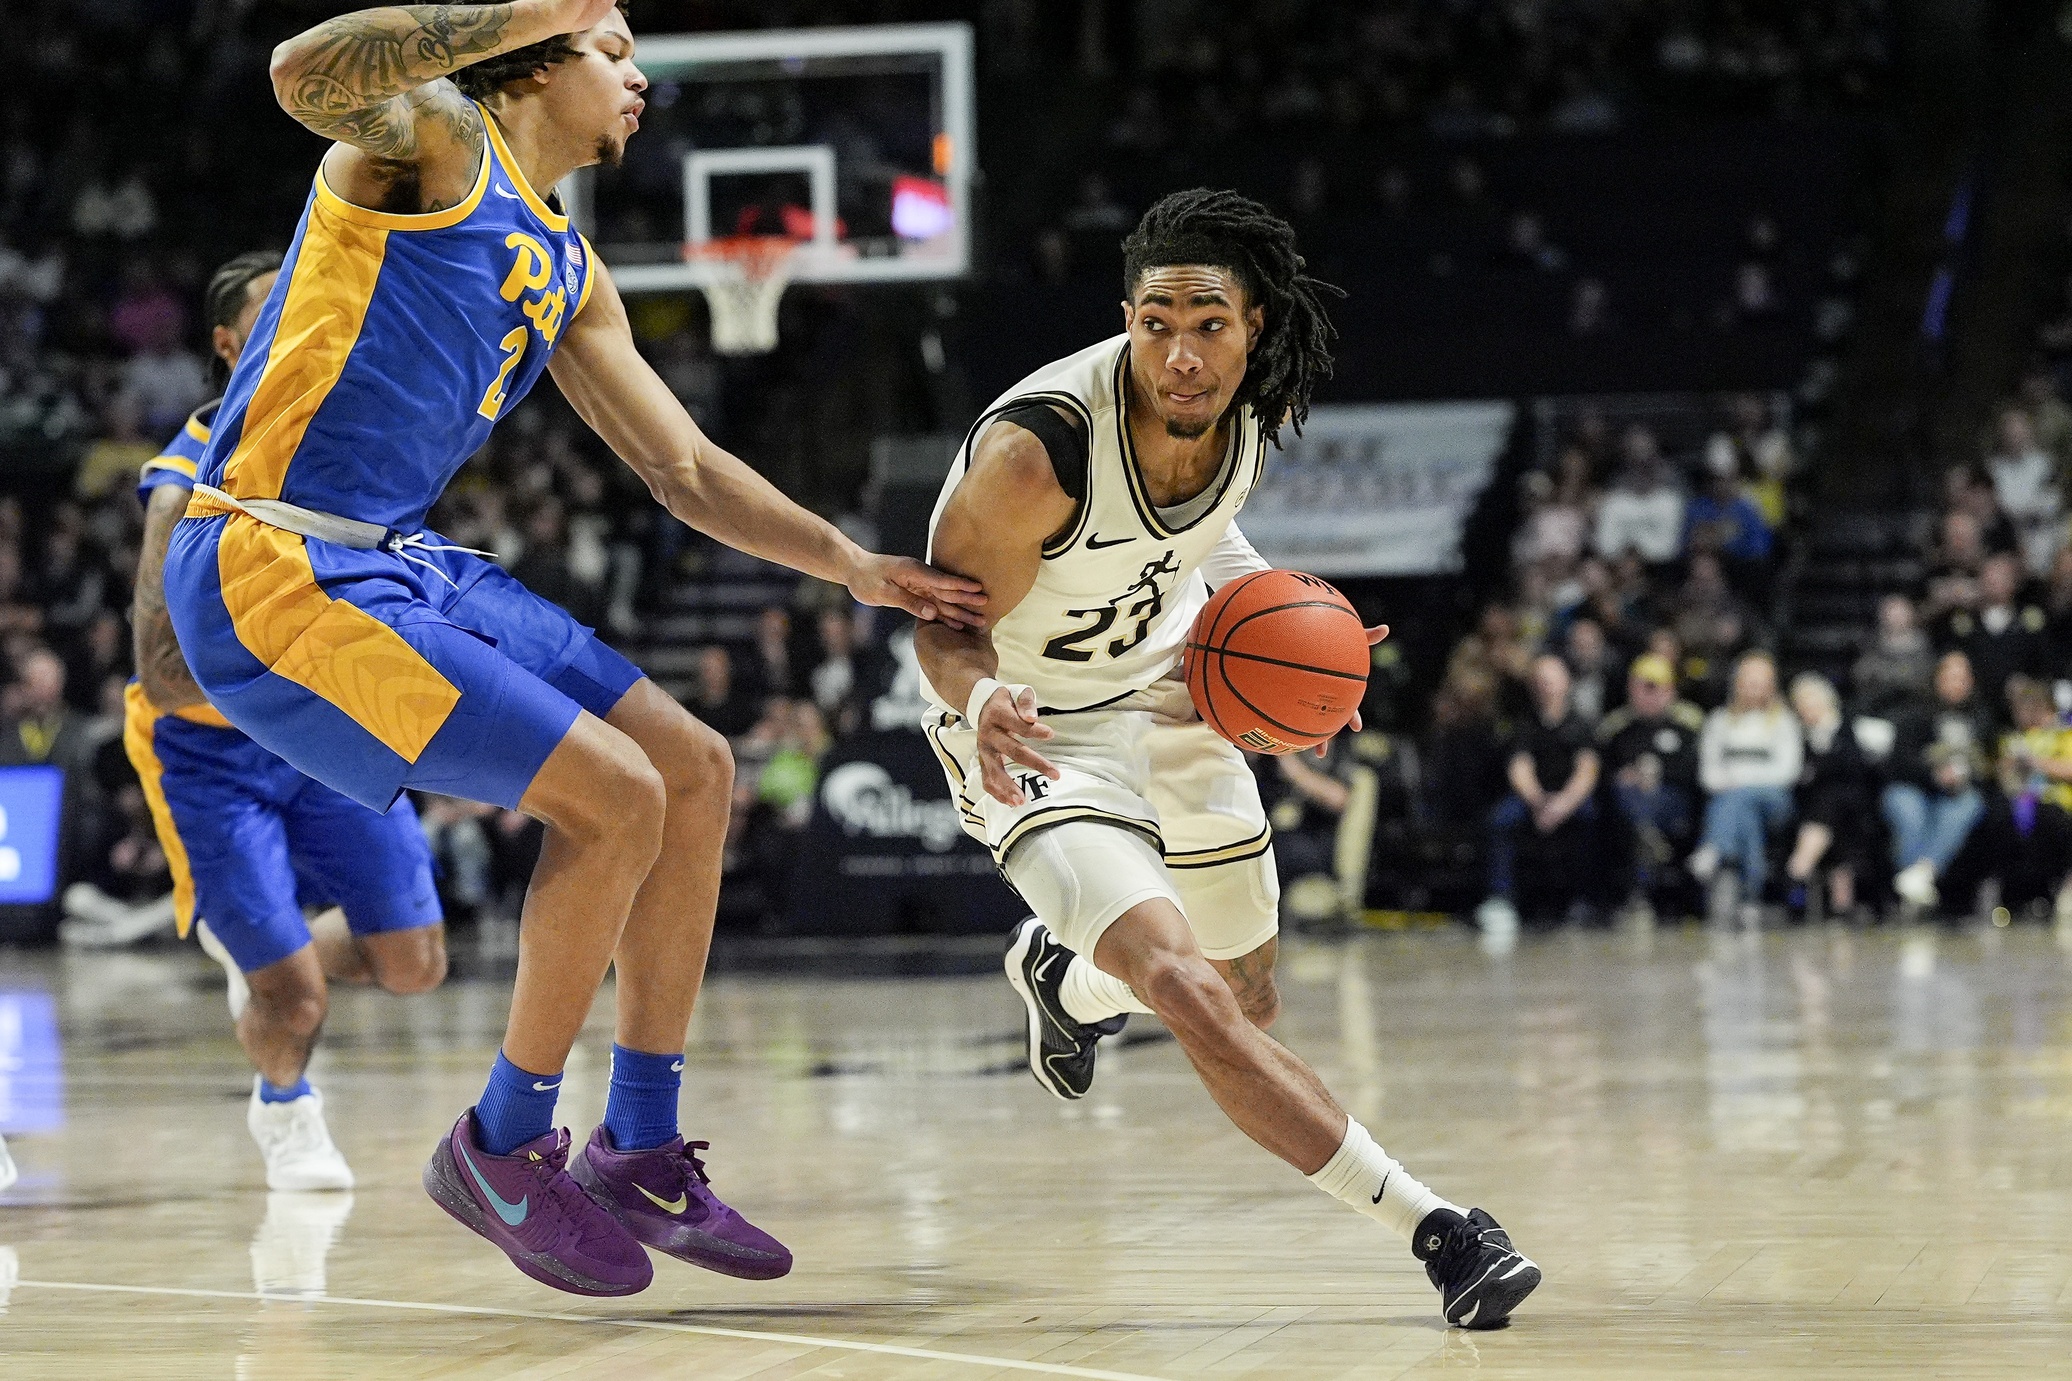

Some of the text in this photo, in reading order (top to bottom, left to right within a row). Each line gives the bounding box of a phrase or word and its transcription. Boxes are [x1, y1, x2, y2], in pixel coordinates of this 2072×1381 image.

[499, 232, 567, 350] Pitt
[477, 325, 528, 421] 2
[1038, 596, 1163, 662] 23
